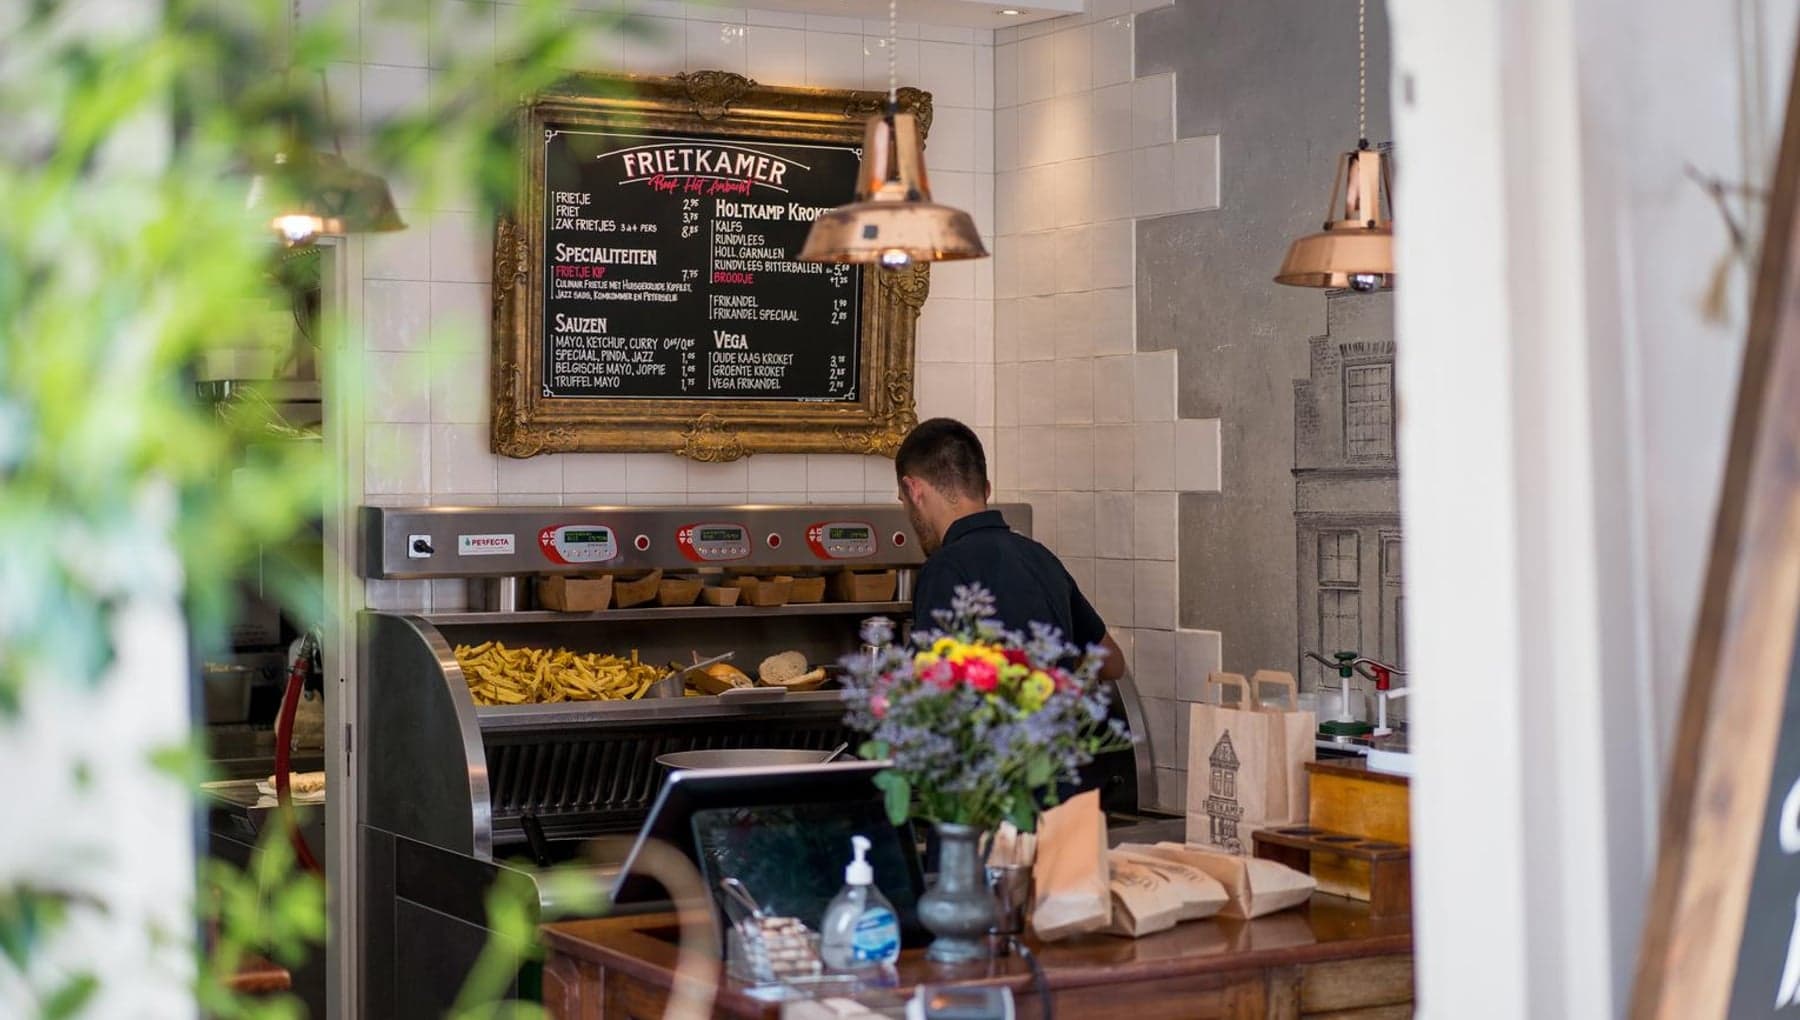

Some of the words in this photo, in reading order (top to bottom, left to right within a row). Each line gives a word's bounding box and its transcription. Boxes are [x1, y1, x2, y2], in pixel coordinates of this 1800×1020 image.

[622, 149, 787, 184] FRIETKAMER
[556, 192, 591, 205] FRIETJE
[556, 205, 580, 217] FRIET
[715, 199, 785, 220] HOLTKAMP
[555, 218, 574, 230] ZAK
[575, 219, 616, 232] FRIETJES
[715, 220, 743, 233] KALFS
[715, 234, 765, 246] RUNDVLEES
[555, 243, 657, 265] SPECIALITEITEN
[739, 248, 785, 260] GARNALEN
[555, 265, 591, 278] FRIETJE
[592, 266, 606, 278] KIP
[714, 260, 763, 272] RUNDVLEES
[765, 261, 823, 274] BITTERBALLEN
[714, 272, 754, 284] BROODJE
[713, 295, 759, 308] FRIKANDEL
[713, 308, 758, 320] FRIKANDEL
[759, 309, 799, 322] SPECIAAL
[555, 313, 607, 333] SAUZEN
[629, 338, 658, 350] CURRY
[713, 330, 749, 349] VEGA
[631, 351, 654, 363] JAZZ
[712, 352, 737, 364] OUDE
[737, 352, 761, 364] KAAS
[762, 353, 794, 366] KROKET
[555, 362, 604, 374] BELGISCHE
[636, 364, 666, 376] JOPPIE
[712, 365, 754, 377] GROENTE
[754, 366, 785, 378] KROKET
[554, 376, 592, 388] TRUFFEL
[593, 376, 620, 388] MAYO
[712, 377, 736, 389] VEGA
[736, 378, 781, 390] FRIKANDEL
[471, 538, 510, 547] PERFECTA
